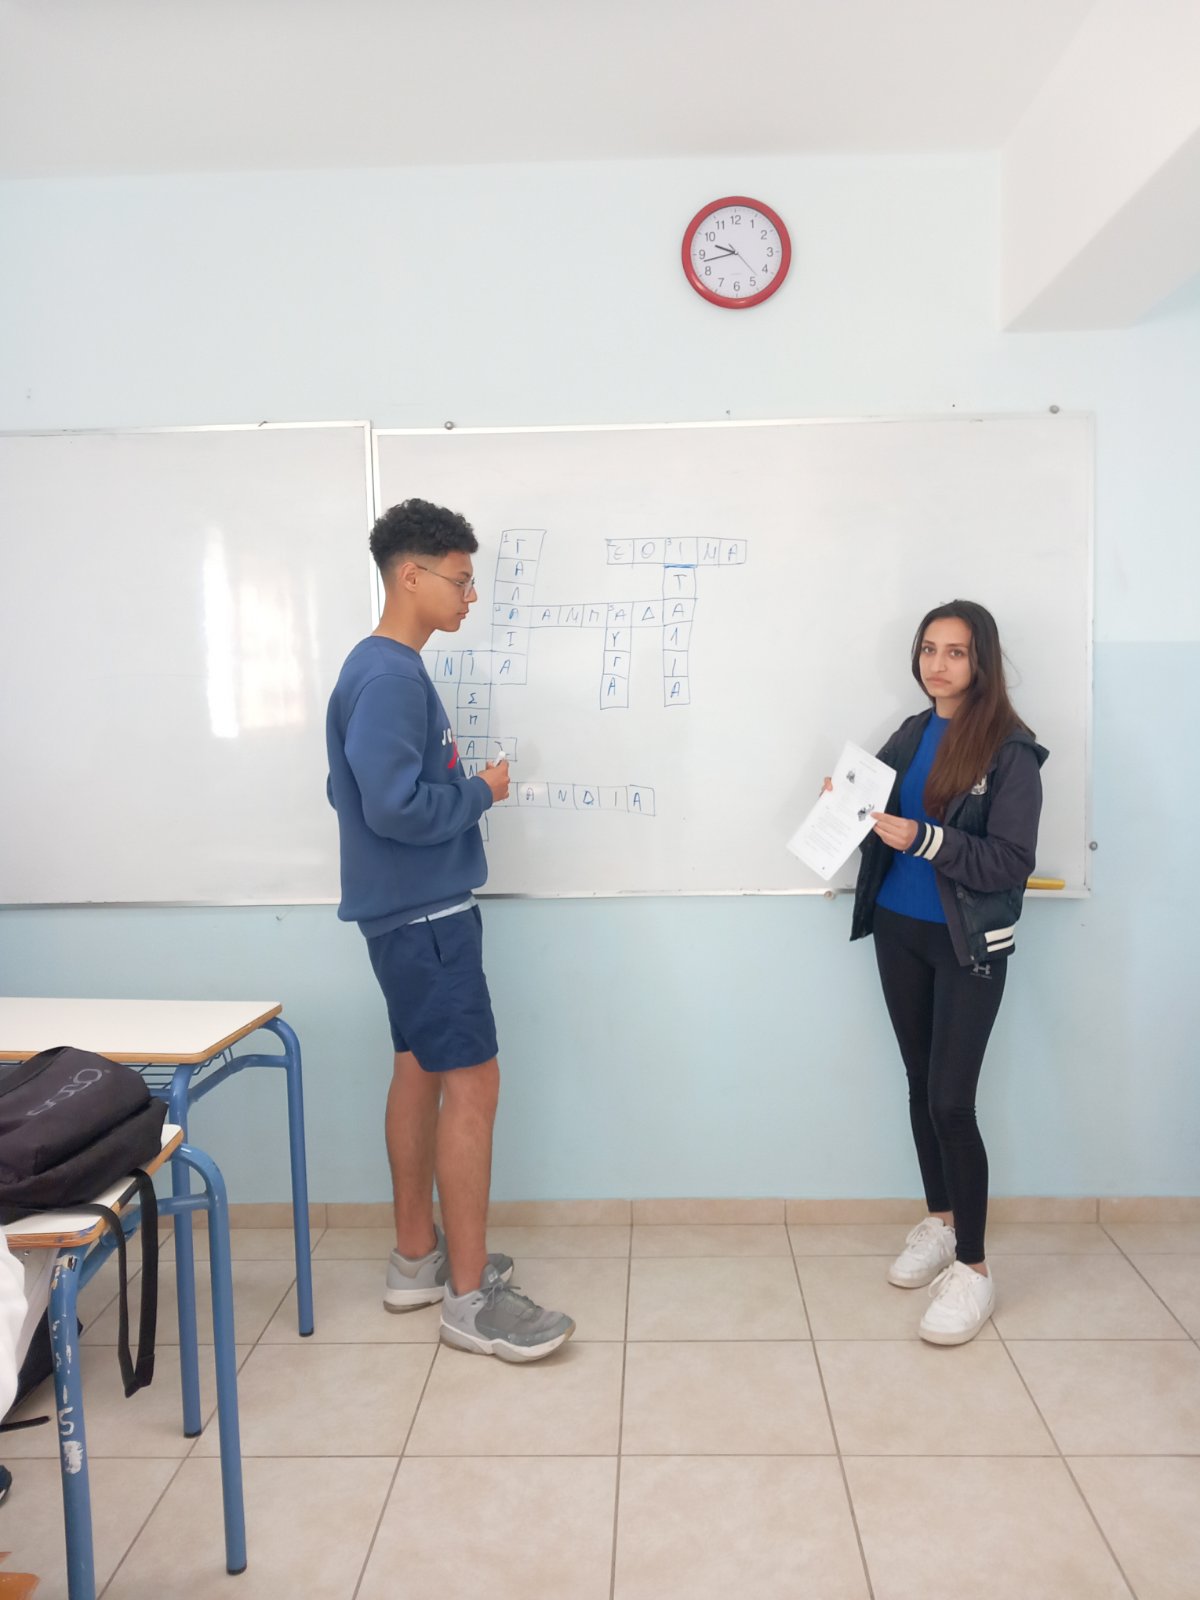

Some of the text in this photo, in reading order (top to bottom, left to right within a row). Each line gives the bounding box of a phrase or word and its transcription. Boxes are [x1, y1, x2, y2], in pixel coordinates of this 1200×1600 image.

[715, 220, 725, 230] 11
[730, 214, 742, 225] 12
[704, 231, 716, 242] 10
[760, 229, 768, 240] 2
[698, 249, 706, 260] 9
[766, 246, 774, 257] 3
[704, 265, 712, 276] 8
[761, 263, 769, 274] 4
[717, 277, 725, 287] 7
[733, 281, 741, 292] 6
[749, 276, 757, 287] 5
